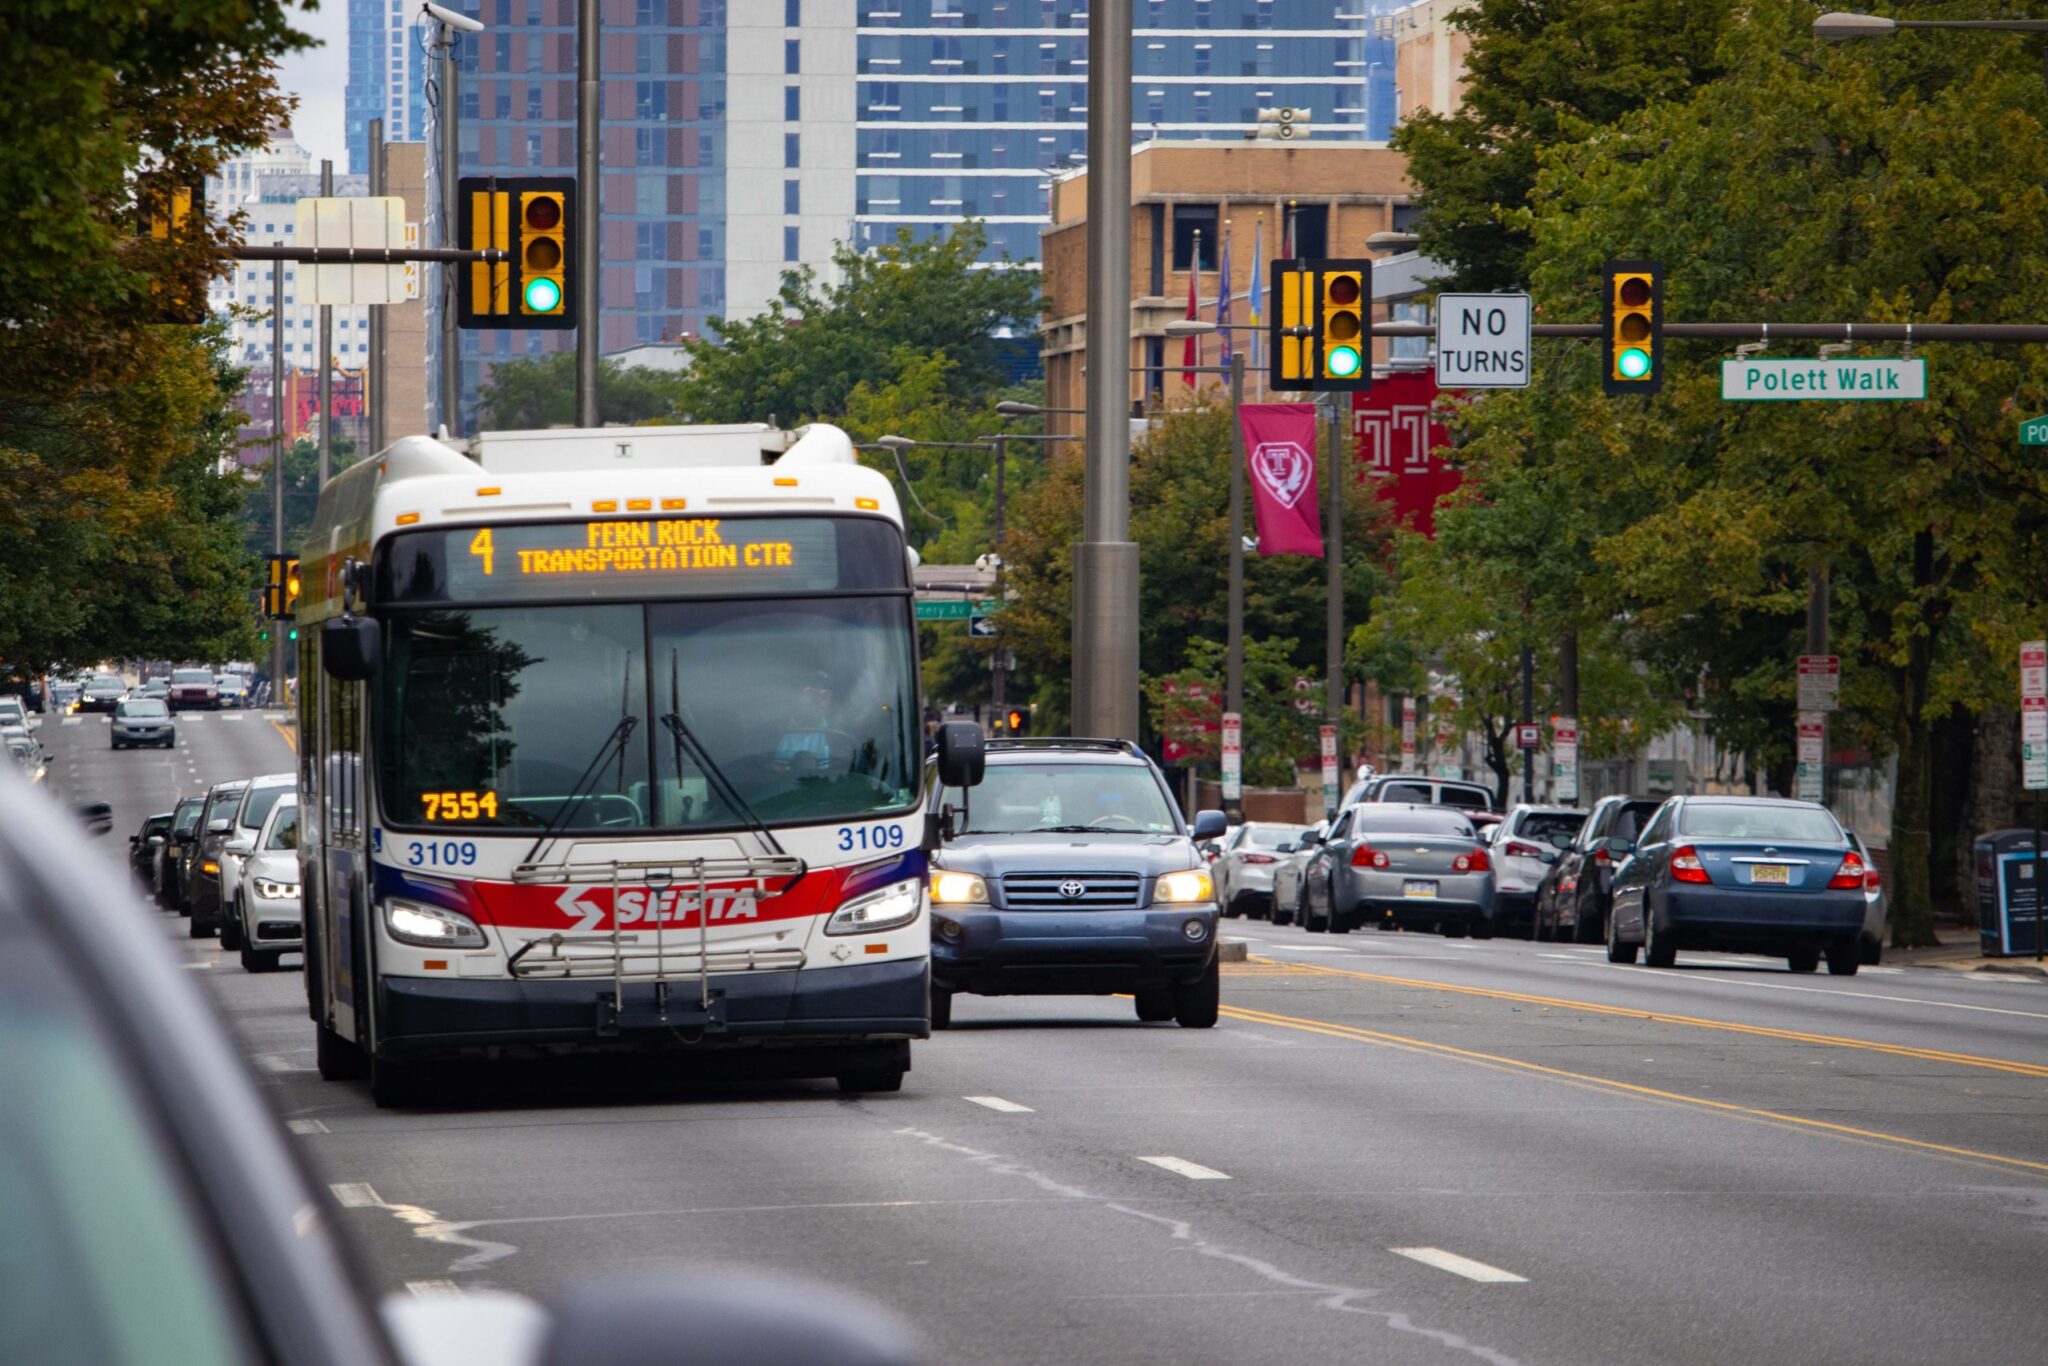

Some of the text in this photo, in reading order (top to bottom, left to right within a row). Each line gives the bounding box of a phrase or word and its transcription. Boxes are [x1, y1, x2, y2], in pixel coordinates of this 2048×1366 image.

[1462, 308, 1506, 335] NO
[1442, 350, 1524, 372] TURNS
[1746, 368, 1900, 390] Polett Walk
[587, 520, 721, 547] FERN ROCK
[469, 528, 494, 575] 4
[517, 542, 793, 573] TRANSPORTATION CTR
[421, 791, 498, 820] 7554
[838, 824, 903, 851] 3109
[408, 842, 476, 866] 3109
[617, 888, 758, 923] SEPTA
